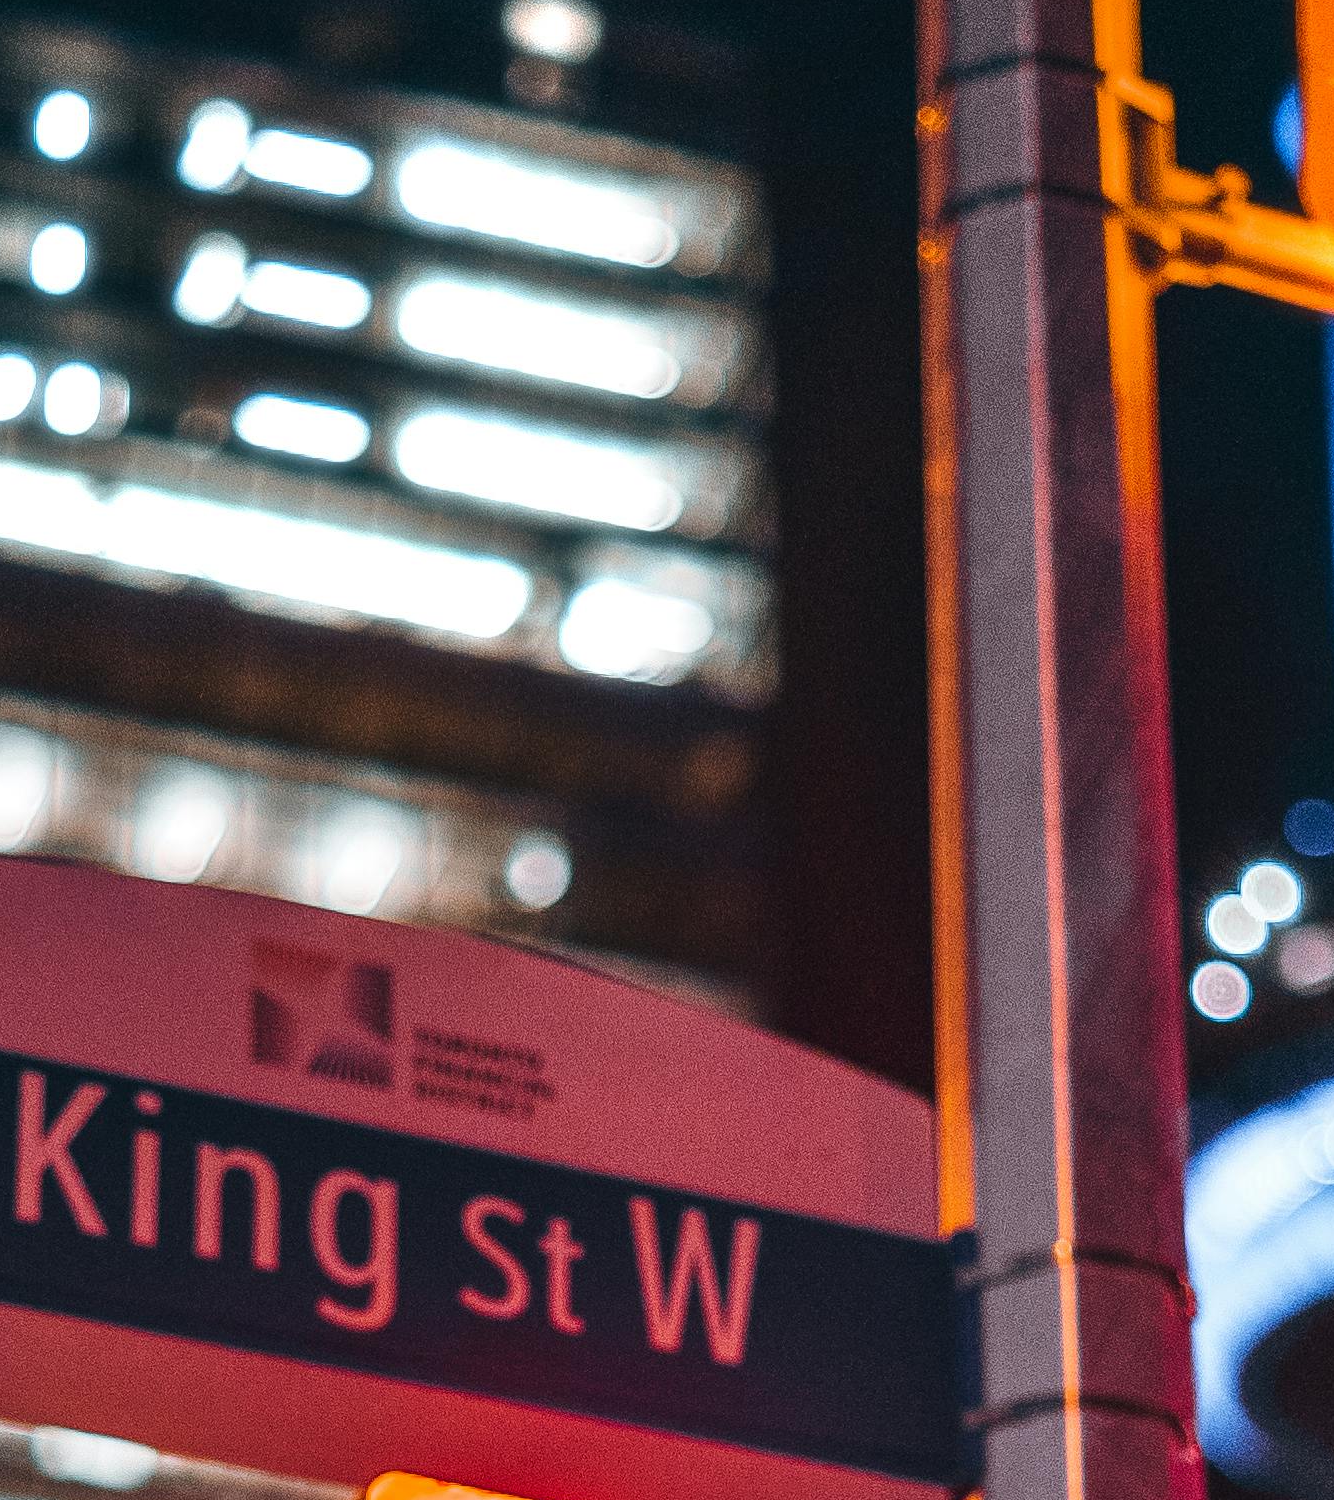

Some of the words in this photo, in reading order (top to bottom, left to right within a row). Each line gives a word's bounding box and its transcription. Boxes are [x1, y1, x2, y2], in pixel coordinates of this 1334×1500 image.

[13, 1070, 399, 1332] King
[459, 1193, 585, 1335] St
[629, 1196, 760, 1366] W
